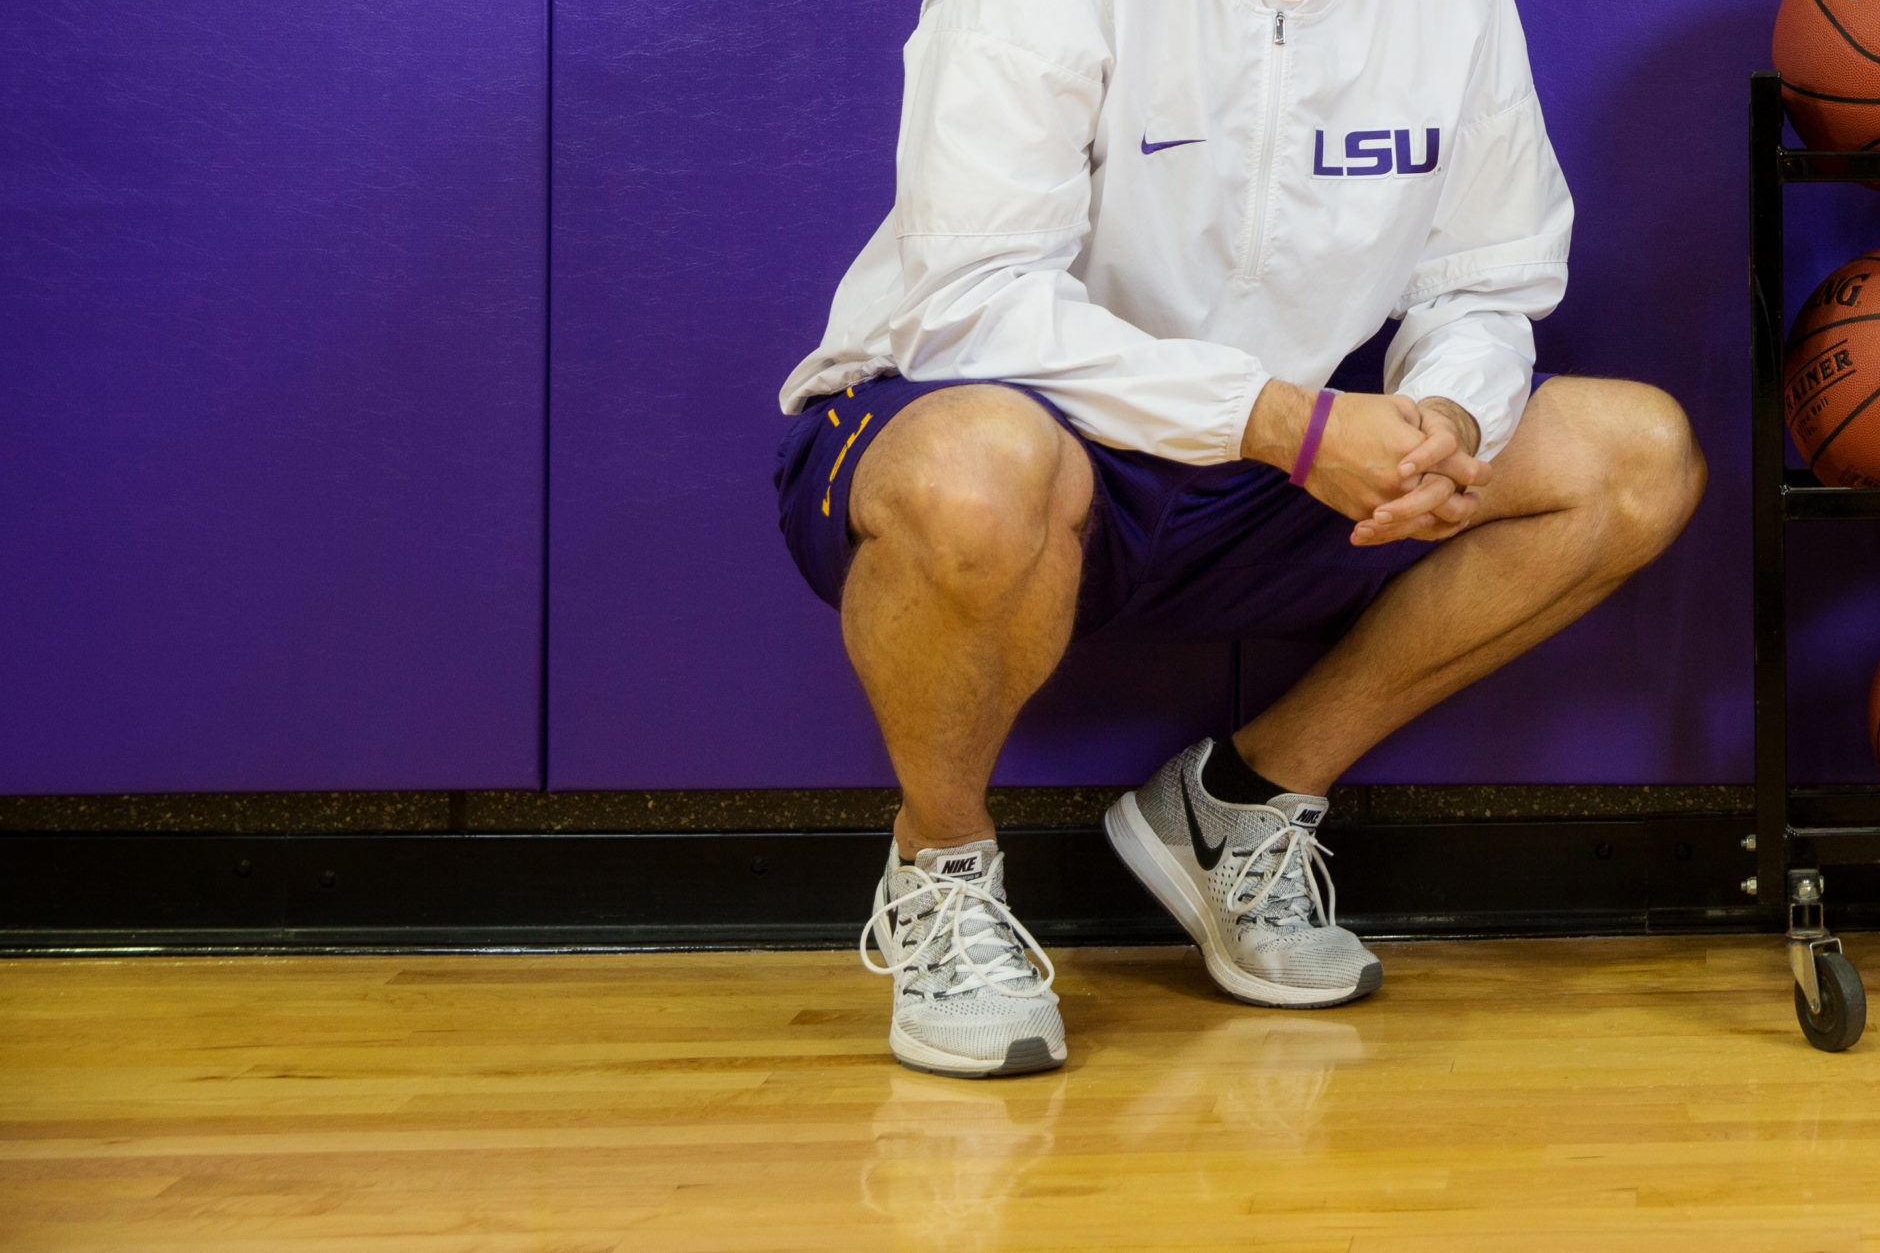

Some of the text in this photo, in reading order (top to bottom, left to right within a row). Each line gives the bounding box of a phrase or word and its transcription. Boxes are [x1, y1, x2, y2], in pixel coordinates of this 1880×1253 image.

[1313, 127, 1440, 176] LSU
[1296, 808, 1322, 824] NIKE
[941, 856, 978, 874] NIKE
